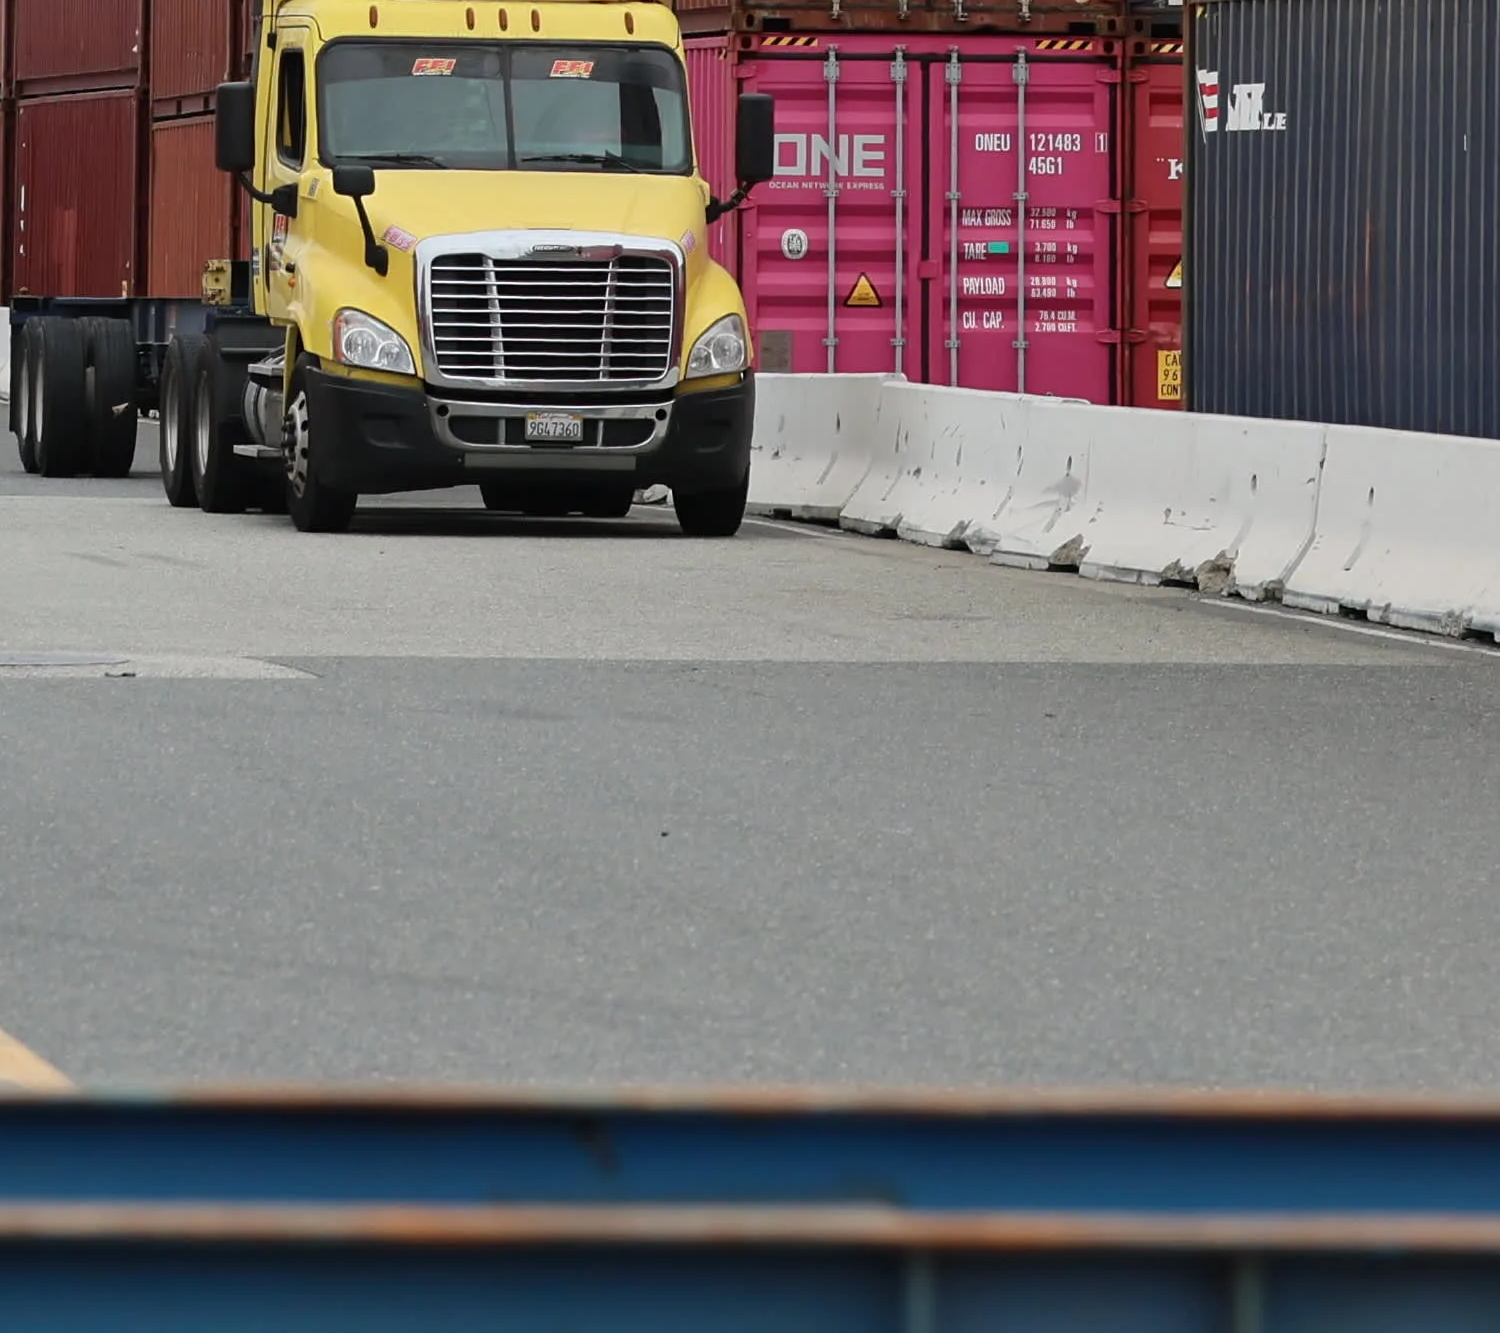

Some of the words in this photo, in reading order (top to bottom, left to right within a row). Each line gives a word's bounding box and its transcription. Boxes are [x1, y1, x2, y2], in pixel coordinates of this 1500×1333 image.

[975, 133, 1010, 152] ONEU
[1029, 133, 1081, 152] 121483
[773, 133, 885, 177] ONE
[1029, 156, 1063, 175] 45G1
[769, 182, 799, 190] OCEAN
[847, 182, 885, 190] EXPRESS
[962, 210, 982, 226] MAX
[984, 209, 1012, 226] GROSS
[964, 243, 987, 260] TARE
[963, 277, 1005, 295] PAYLOAD
[530, 421, 579, 437] 9G47360
